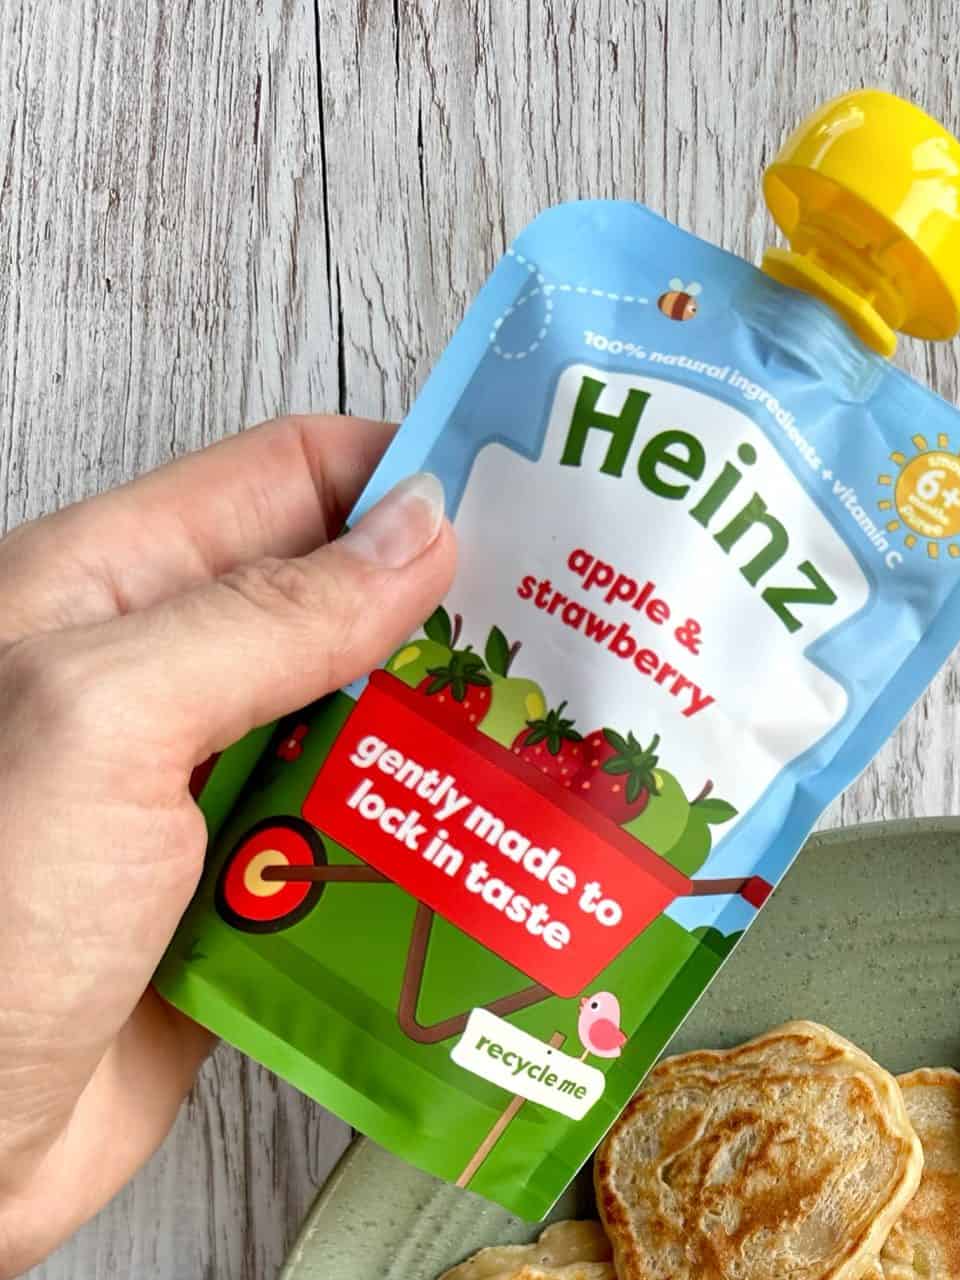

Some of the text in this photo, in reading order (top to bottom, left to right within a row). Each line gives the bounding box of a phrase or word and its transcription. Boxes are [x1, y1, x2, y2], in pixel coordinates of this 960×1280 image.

[560, 375, 838, 633] Heinz
[584, 330, 903, 569] 100% natural ingredients + vitamin C
[516, 574, 716, 719] strawberry
[567, 547, 704, 656] apple &
[346, 779, 572, 950] lock in taste
[349, 733, 623, 928] gently made to
[474, 1034, 588, 1101] recycle me
